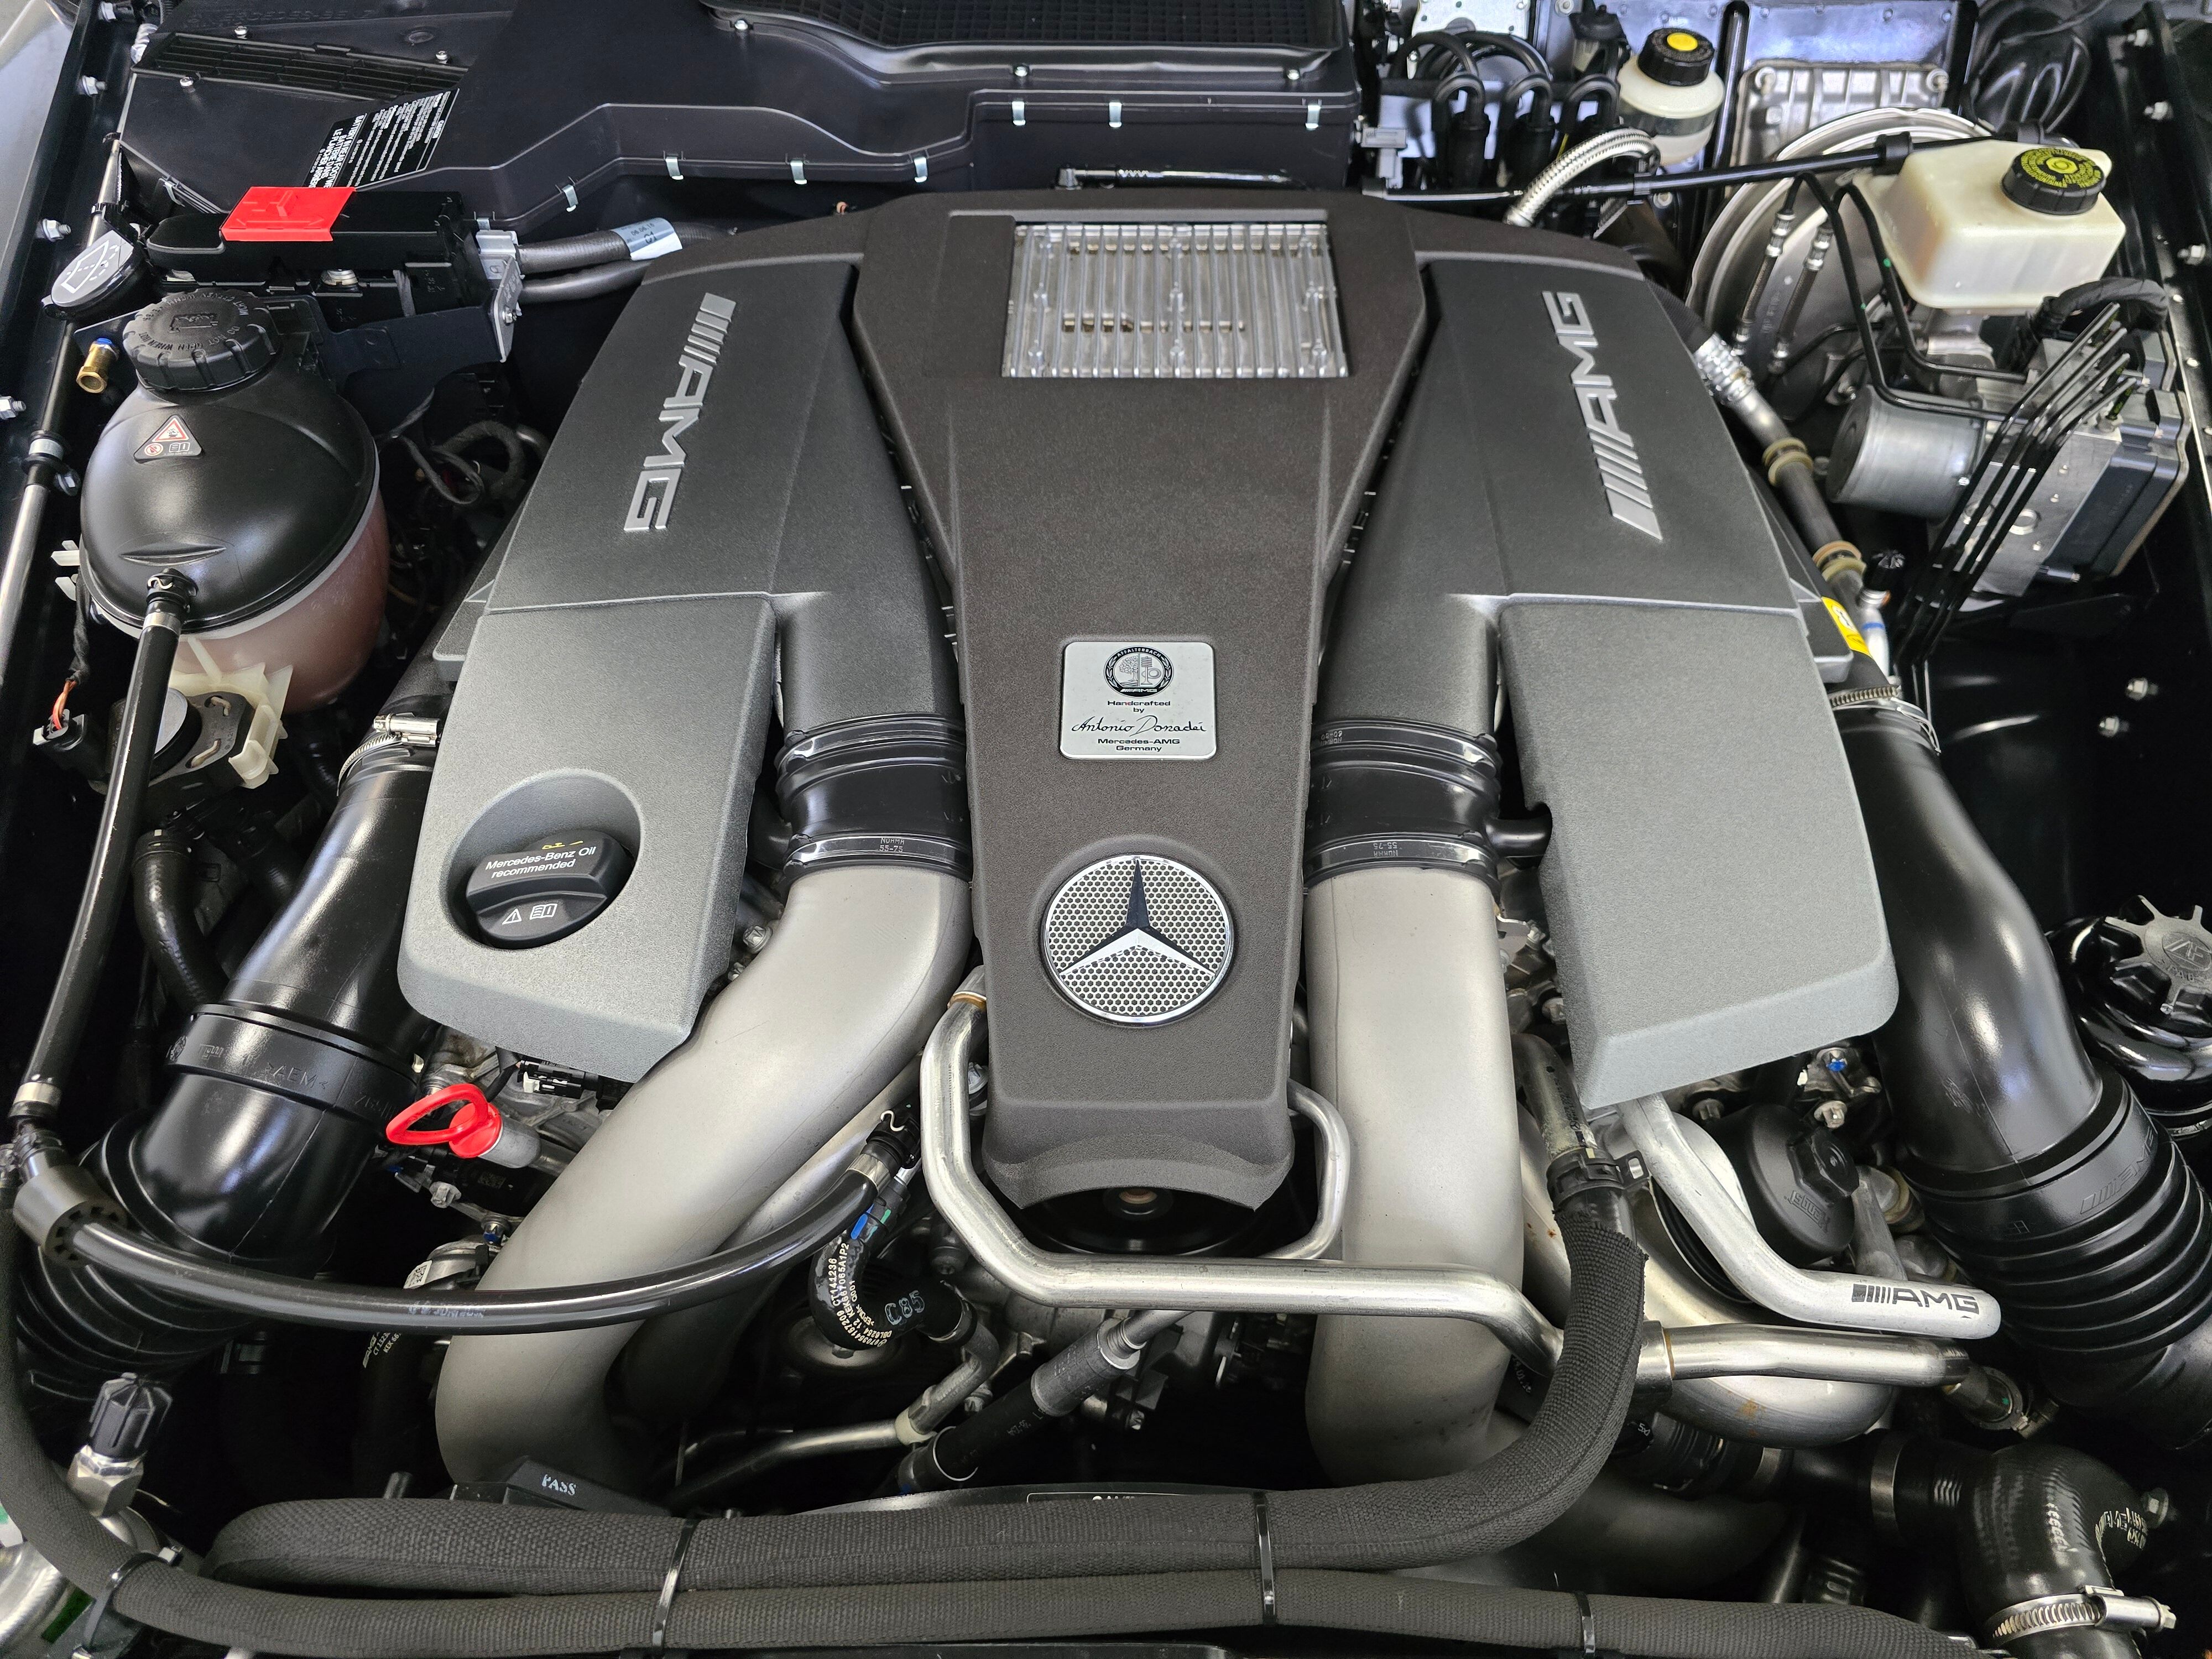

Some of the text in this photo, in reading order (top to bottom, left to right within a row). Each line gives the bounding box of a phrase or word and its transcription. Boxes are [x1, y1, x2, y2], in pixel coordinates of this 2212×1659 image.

[345, 114, 363, 140] BATTERY
[335, 146, 348, 163] REAR
[208, 334, 227, 346] NOT
[227, 326, 241, 335] DO
[148, 340, 173, 350] WHEN
[623, 355, 714, 532] AMG
[1071, 716, 1135, 732] Antonio
[486, 846, 597, 870] Mercedes-Benz Oil
[492, 859, 576, 878] recommended
[828, 1258, 841, 1306] CT141236
[885, 1290, 925, 1326] C85
[1892, 1287, 1979, 1314] AMG
[392, 1333, 402, 1343] 66
[541, 1474, 577, 1496] PASS
